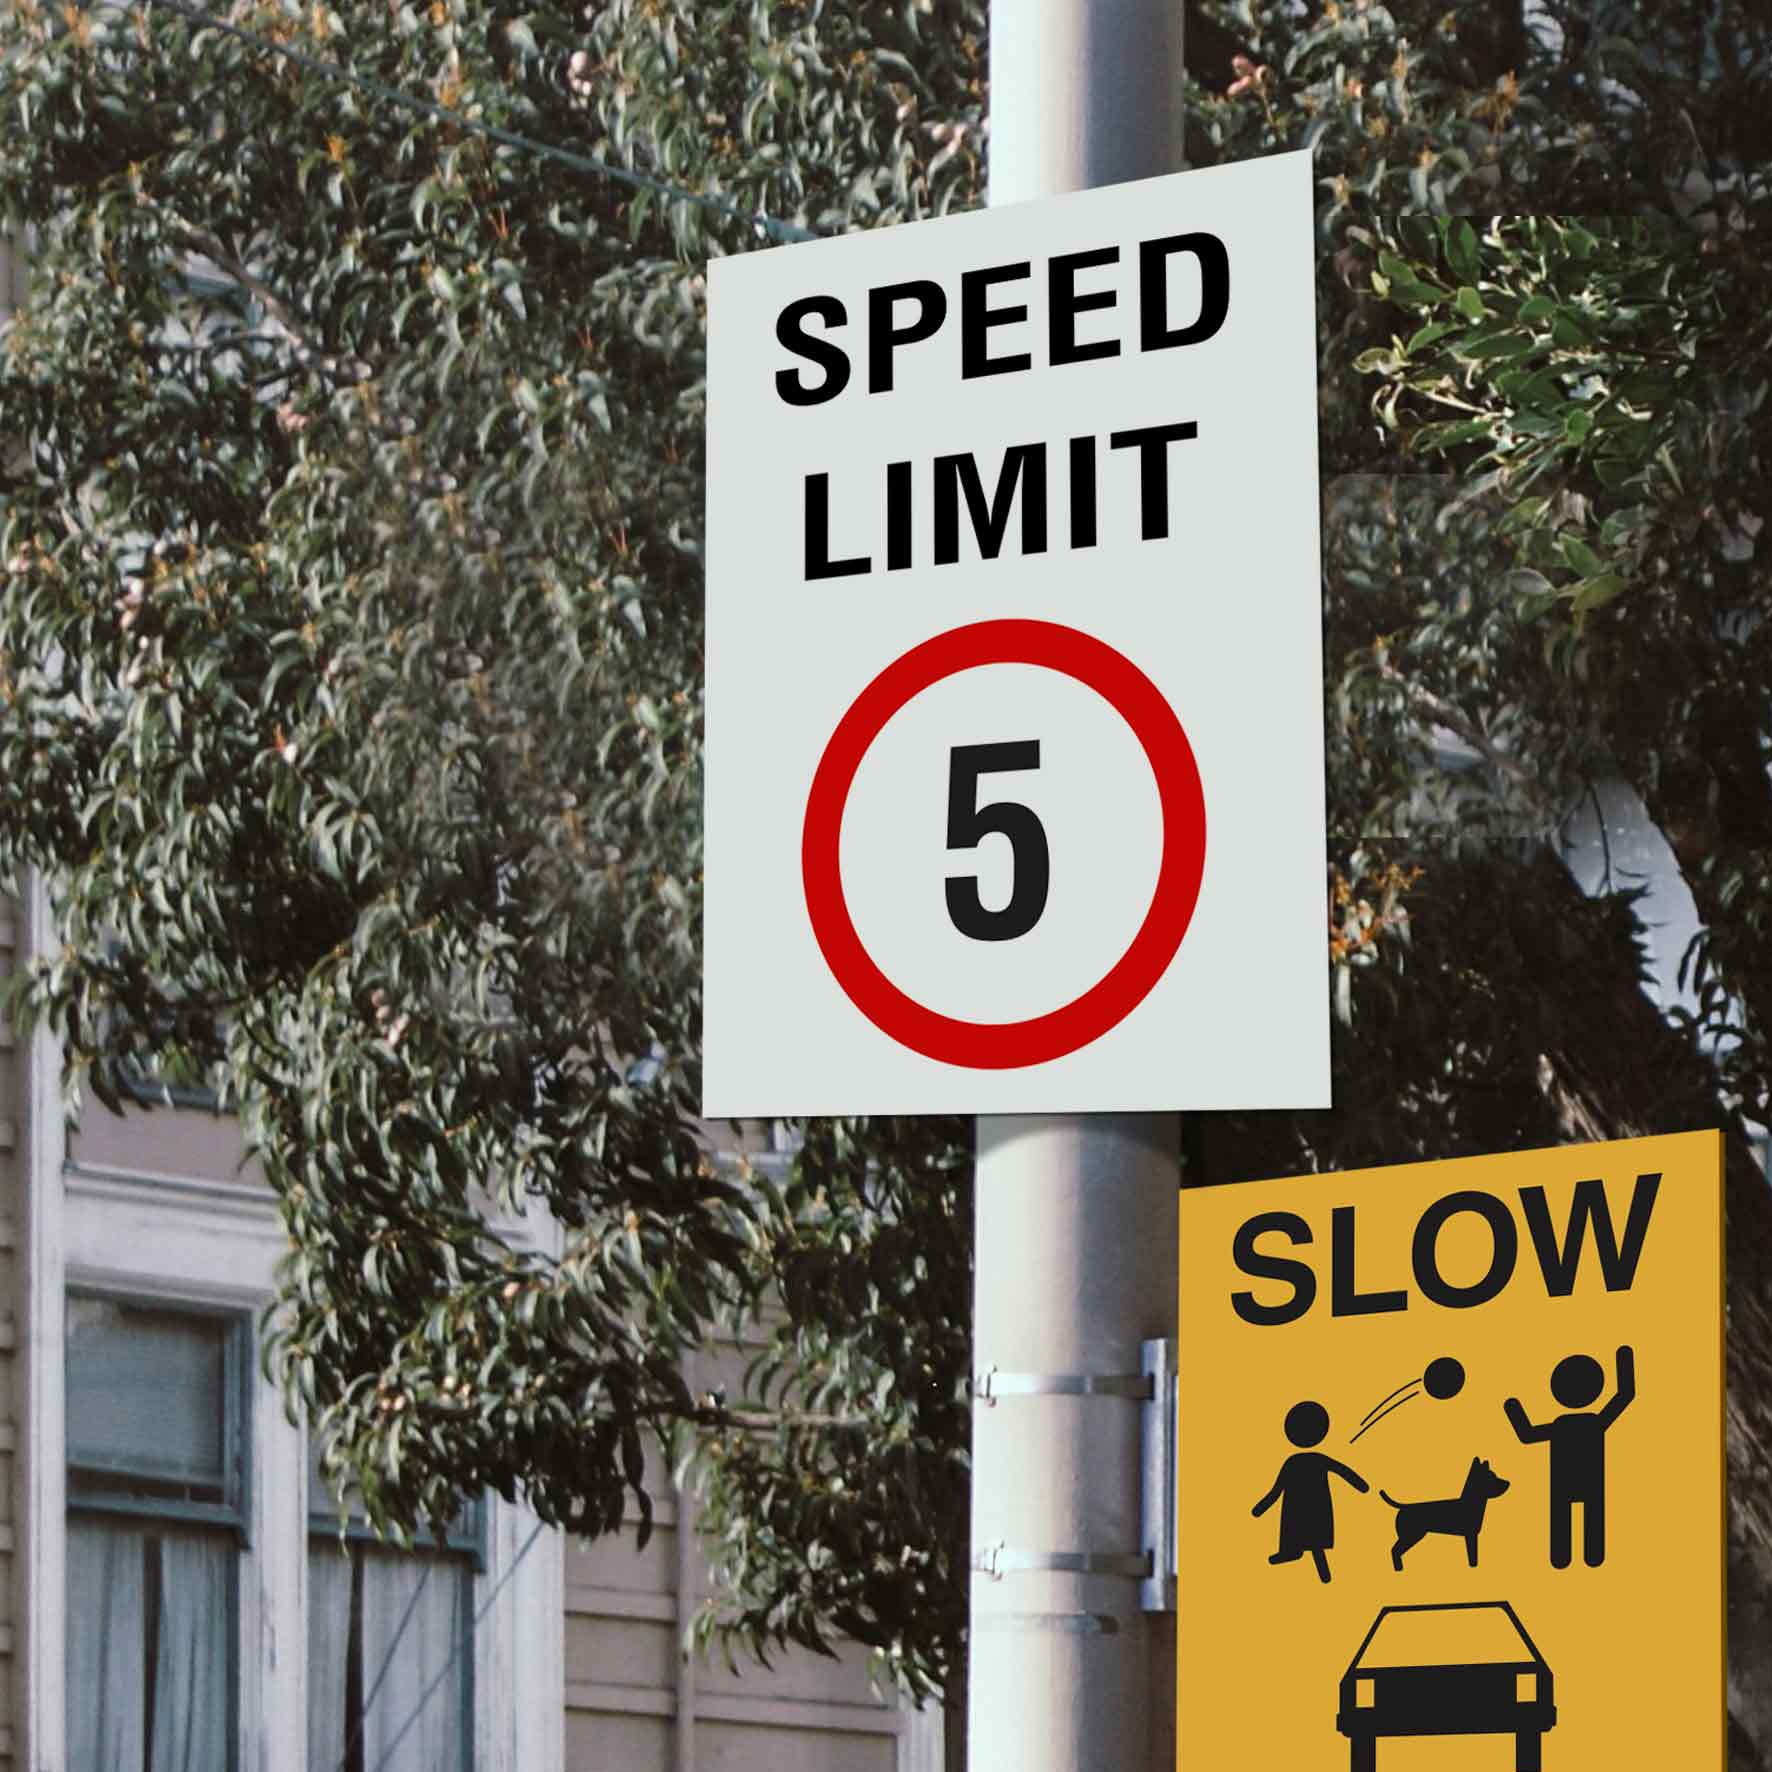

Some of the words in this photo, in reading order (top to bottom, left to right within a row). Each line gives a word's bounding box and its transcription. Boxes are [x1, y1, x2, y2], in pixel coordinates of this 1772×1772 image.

[774, 230, 1231, 408] SPEED
[804, 421, 1199, 582] LIMIT
[943, 739, 1051, 943] 5
[1229, 1171, 1664, 1327] SLOW
